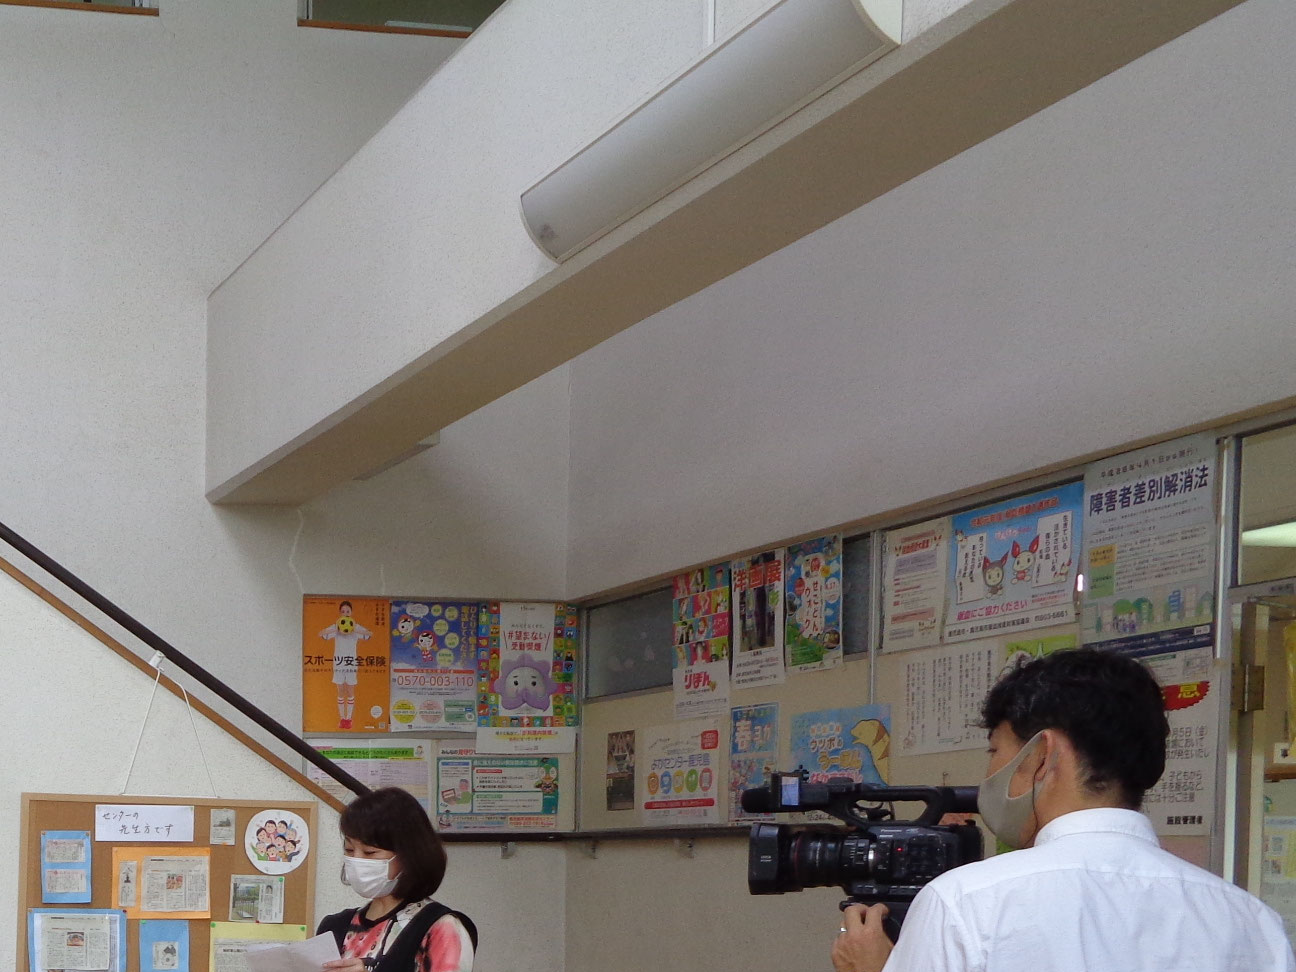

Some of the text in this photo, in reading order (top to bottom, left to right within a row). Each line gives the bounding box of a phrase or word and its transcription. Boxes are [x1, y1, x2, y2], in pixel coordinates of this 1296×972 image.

[1089, 464, 1209, 518] 障害者差別解消法
[733, 559, 782, 593] 洋画展
[304, 655, 386, 667] スポーツ安全保険
[397, 675, 474, 687] 0570-003-110
[101, 810, 140, 821] センターの
[119, 823, 174, 837] 先生方です
